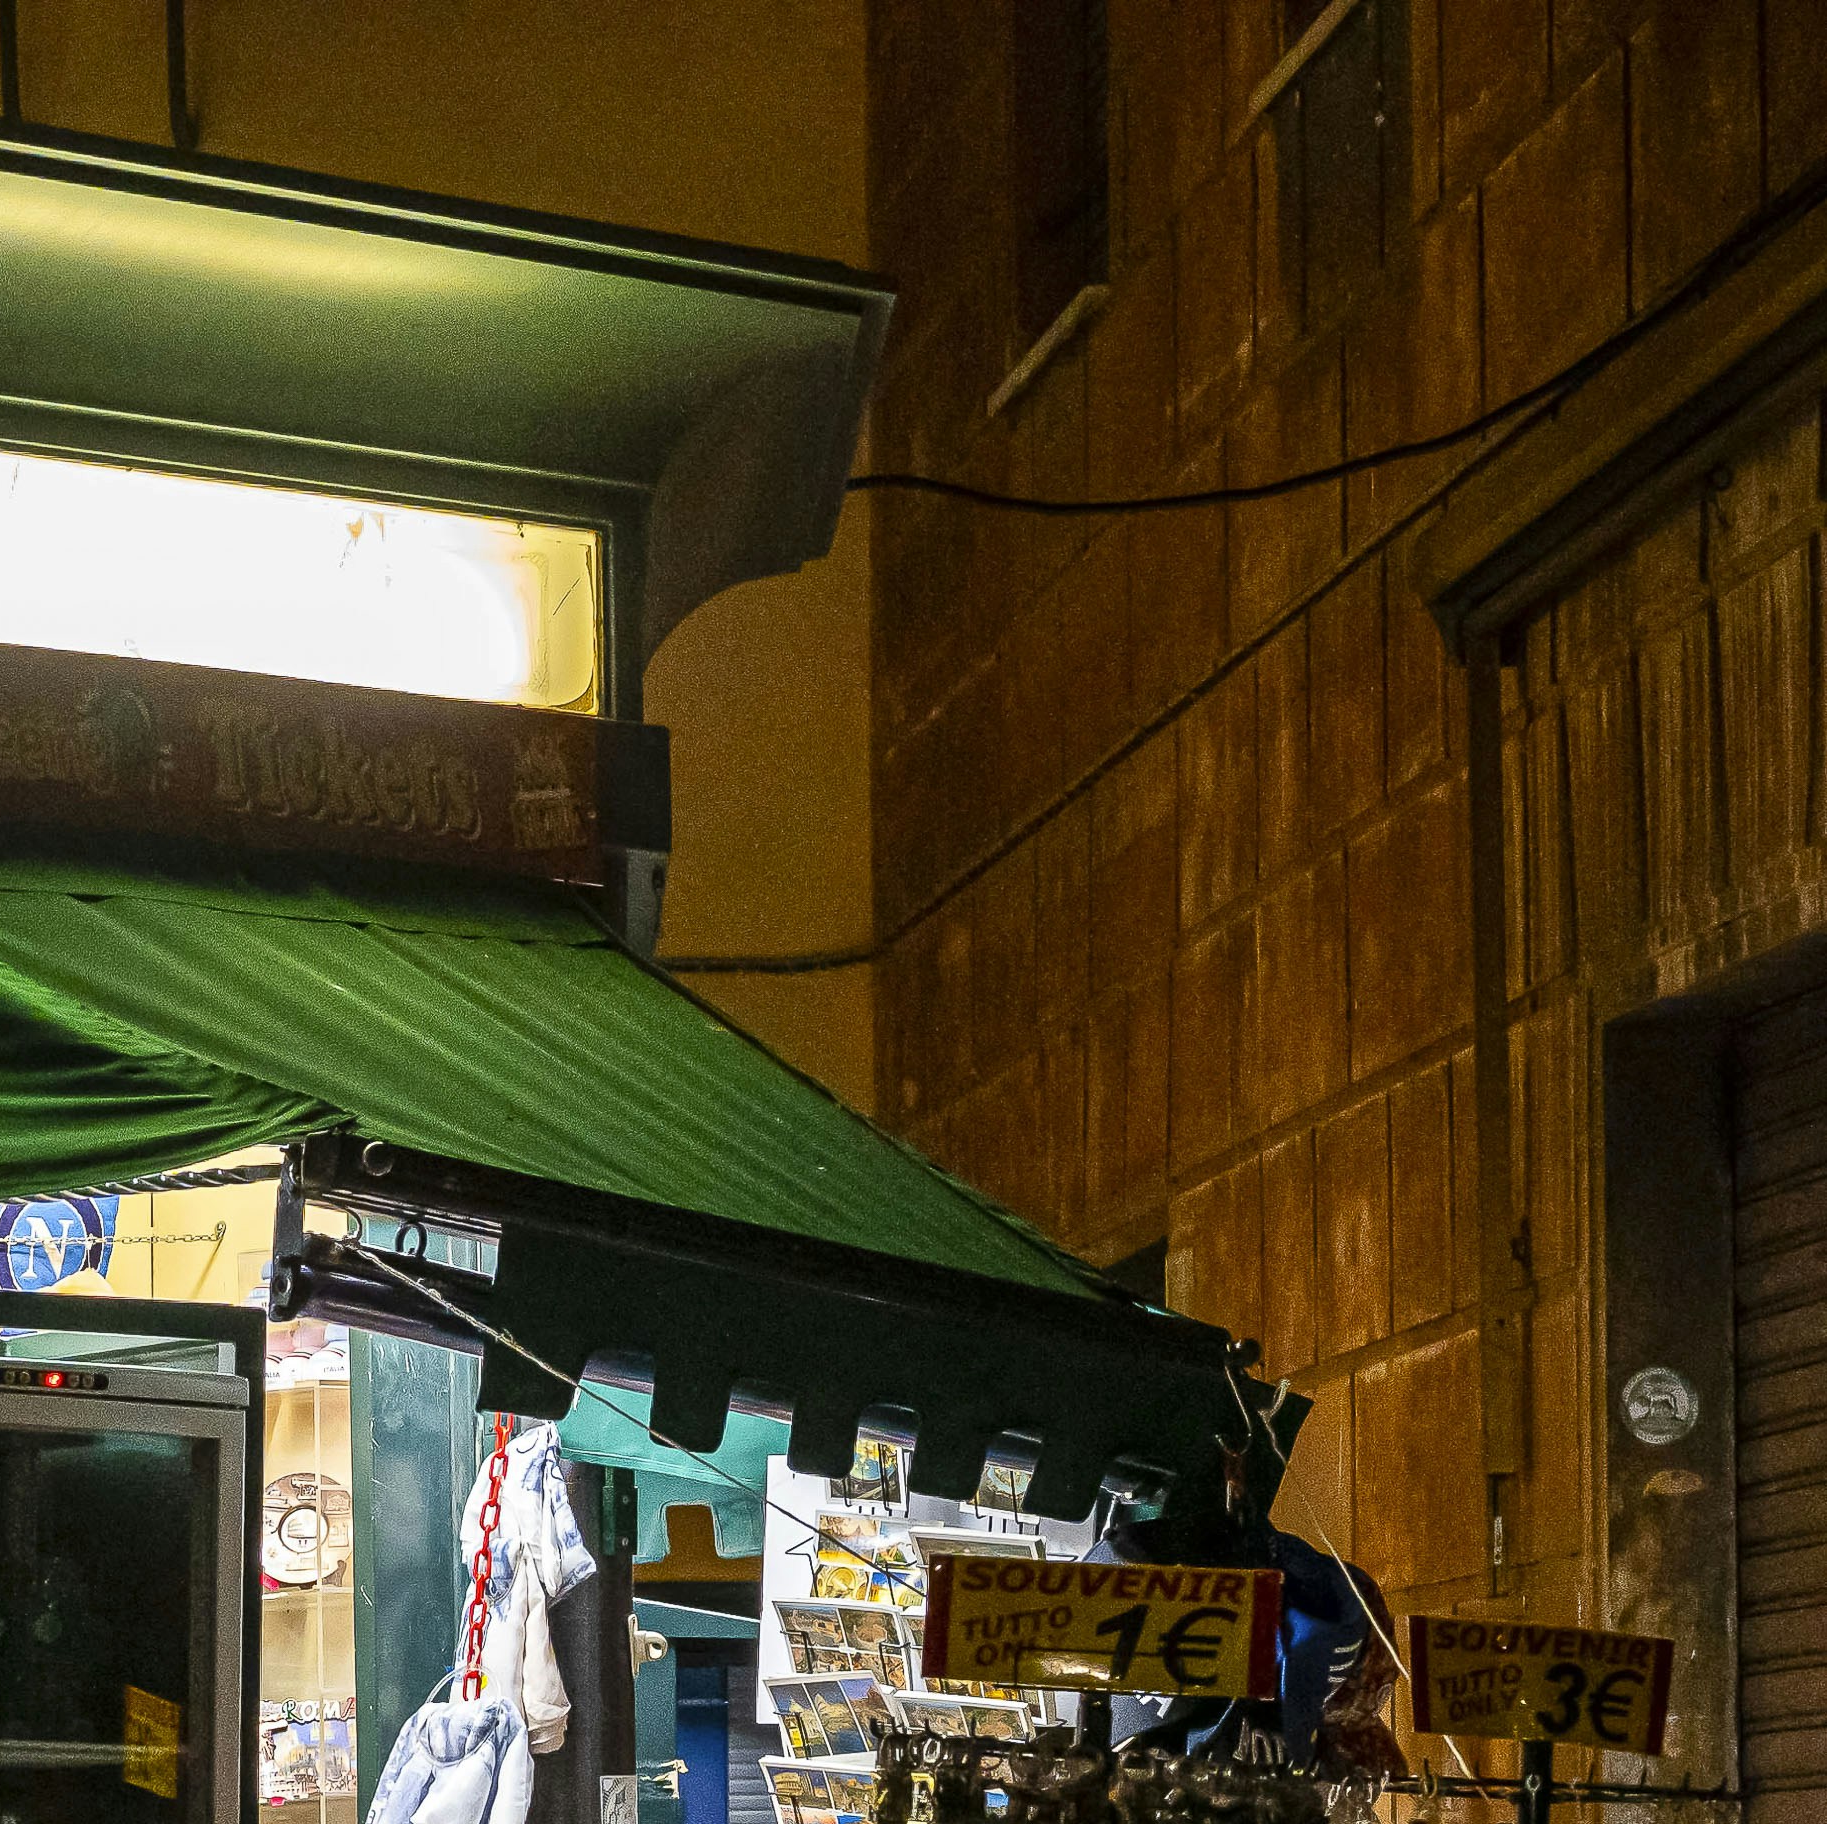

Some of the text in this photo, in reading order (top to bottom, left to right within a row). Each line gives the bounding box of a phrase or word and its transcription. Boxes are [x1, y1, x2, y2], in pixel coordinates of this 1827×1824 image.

[25, 1216, 71, 1281] N
[959, 1561, 1246, 1687] SOUVENIR 1€
[962, 1607, 1073, 1641] TUTTO
[1432, 1621, 1651, 1743] SOUVENIR 3€
[1435, 1664, 1523, 1700] TUTTO
[1446, 1690, 1520, 1722] ONLY
